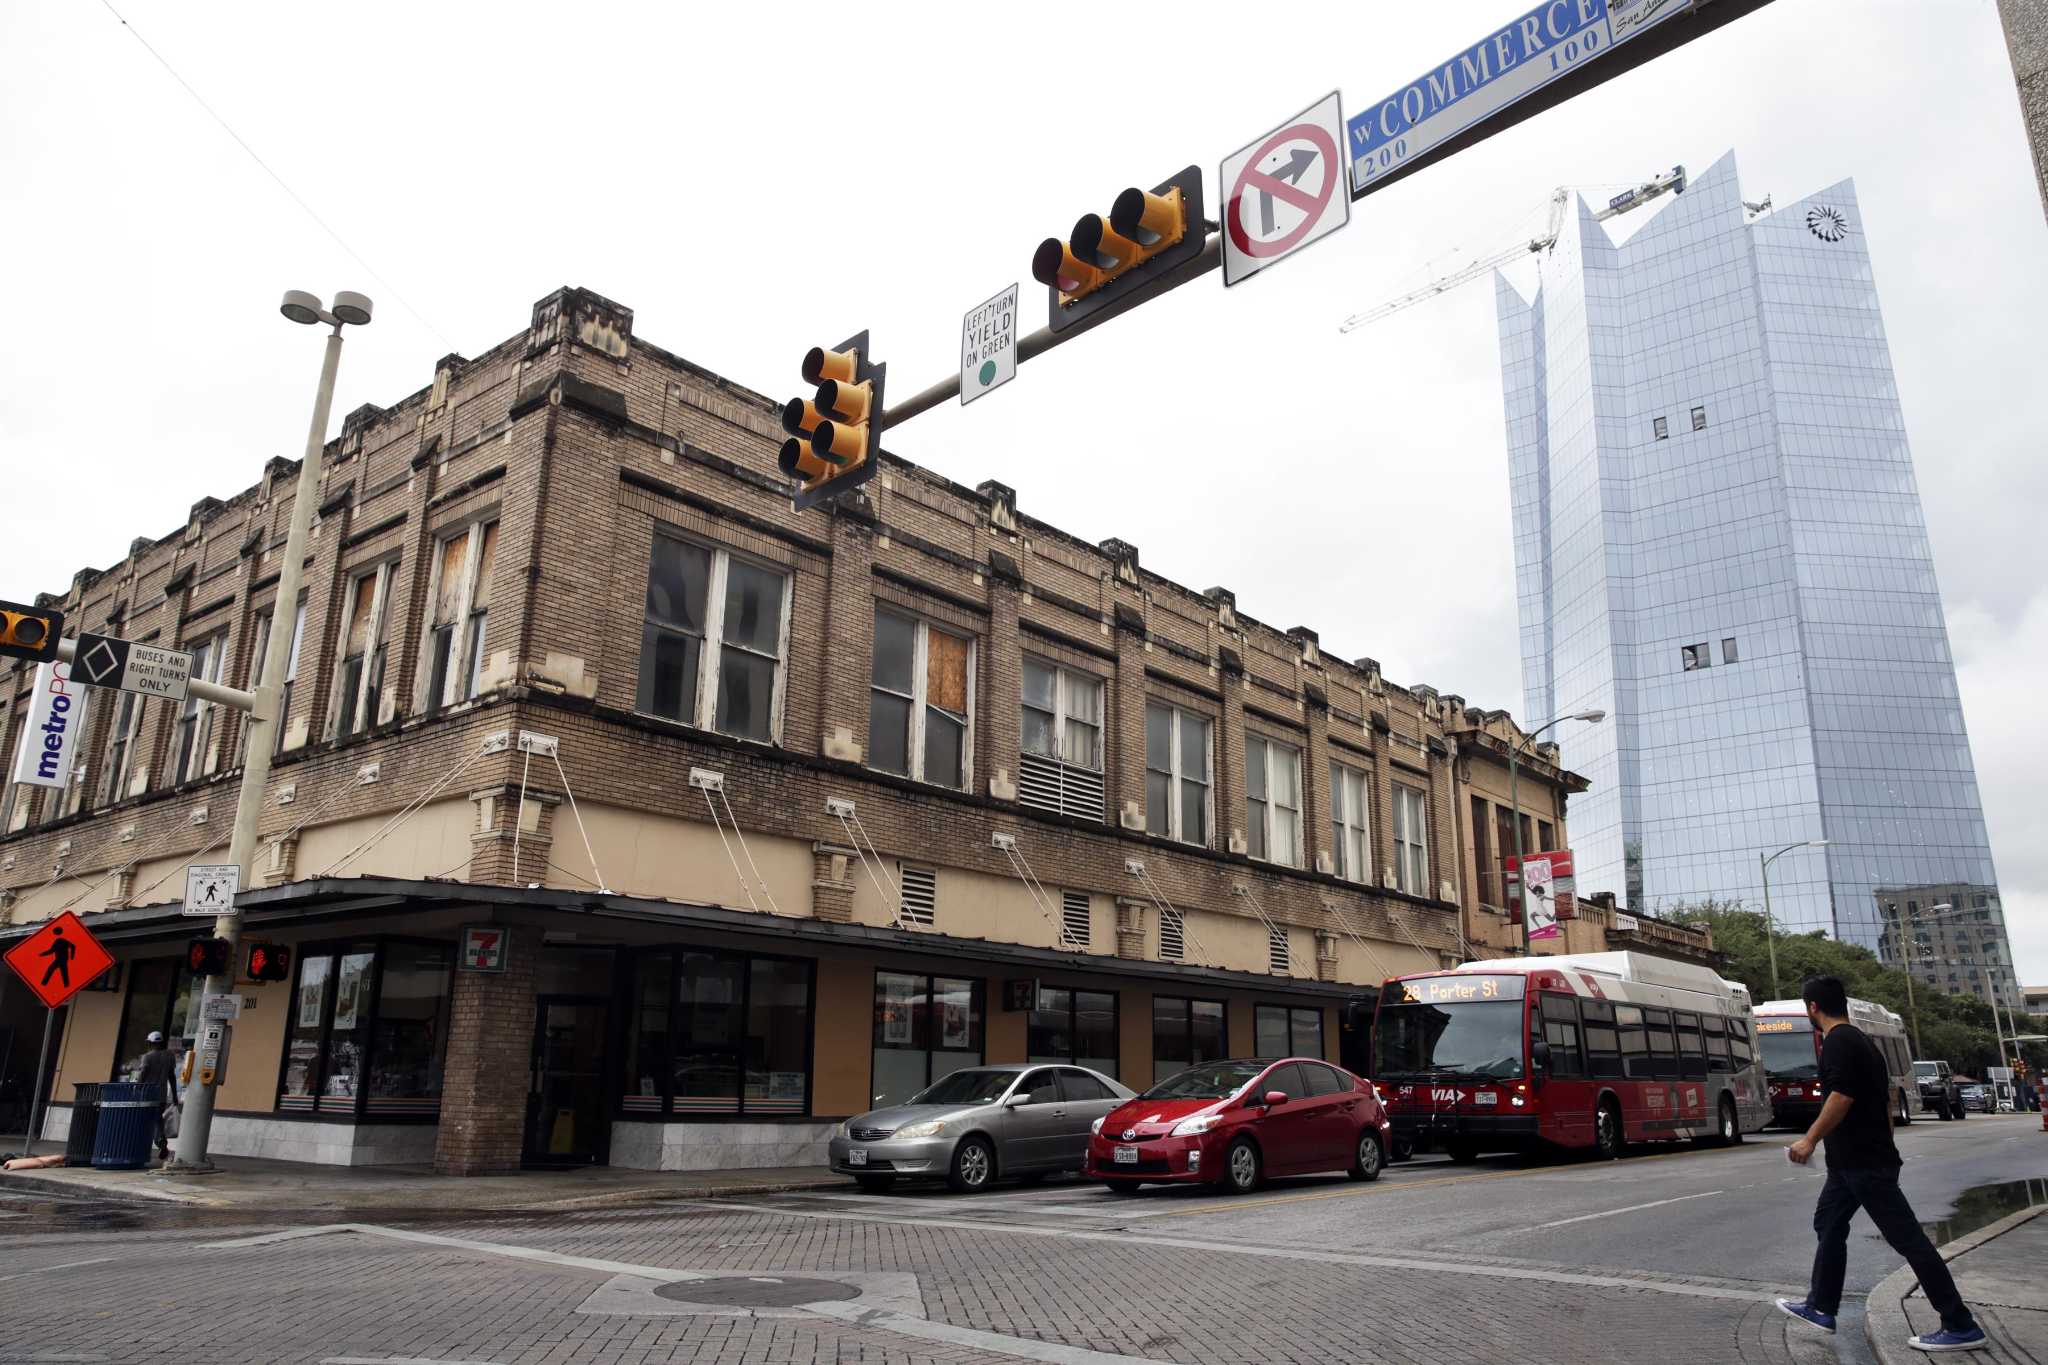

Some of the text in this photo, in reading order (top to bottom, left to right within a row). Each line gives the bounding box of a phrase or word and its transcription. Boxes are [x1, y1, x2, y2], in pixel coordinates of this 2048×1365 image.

[1548, 30, 1599, 72] 100
[1354, 0, 1599, 145] W COMMERCE
[1365, 139, 1407, 177] 200
[967, 293, 1014, 332] LEFT TURN
[969, 312, 1011, 349] YIELD
[966, 332, 1010, 368] ON GREEN
[130, 662, 186, 682] RIGHT TURNS
[136, 649, 185, 668] BUSES AND
[139, 677, 171, 692] ONLY
[37, 660, 73, 779] metroPC
[1430, 982, 1477, 1001] Porter
[1482, 980, 1498, 998] St
[1756, 1019, 1793, 1033] akeside
[1431, 1089, 1455, 1101] VIA
